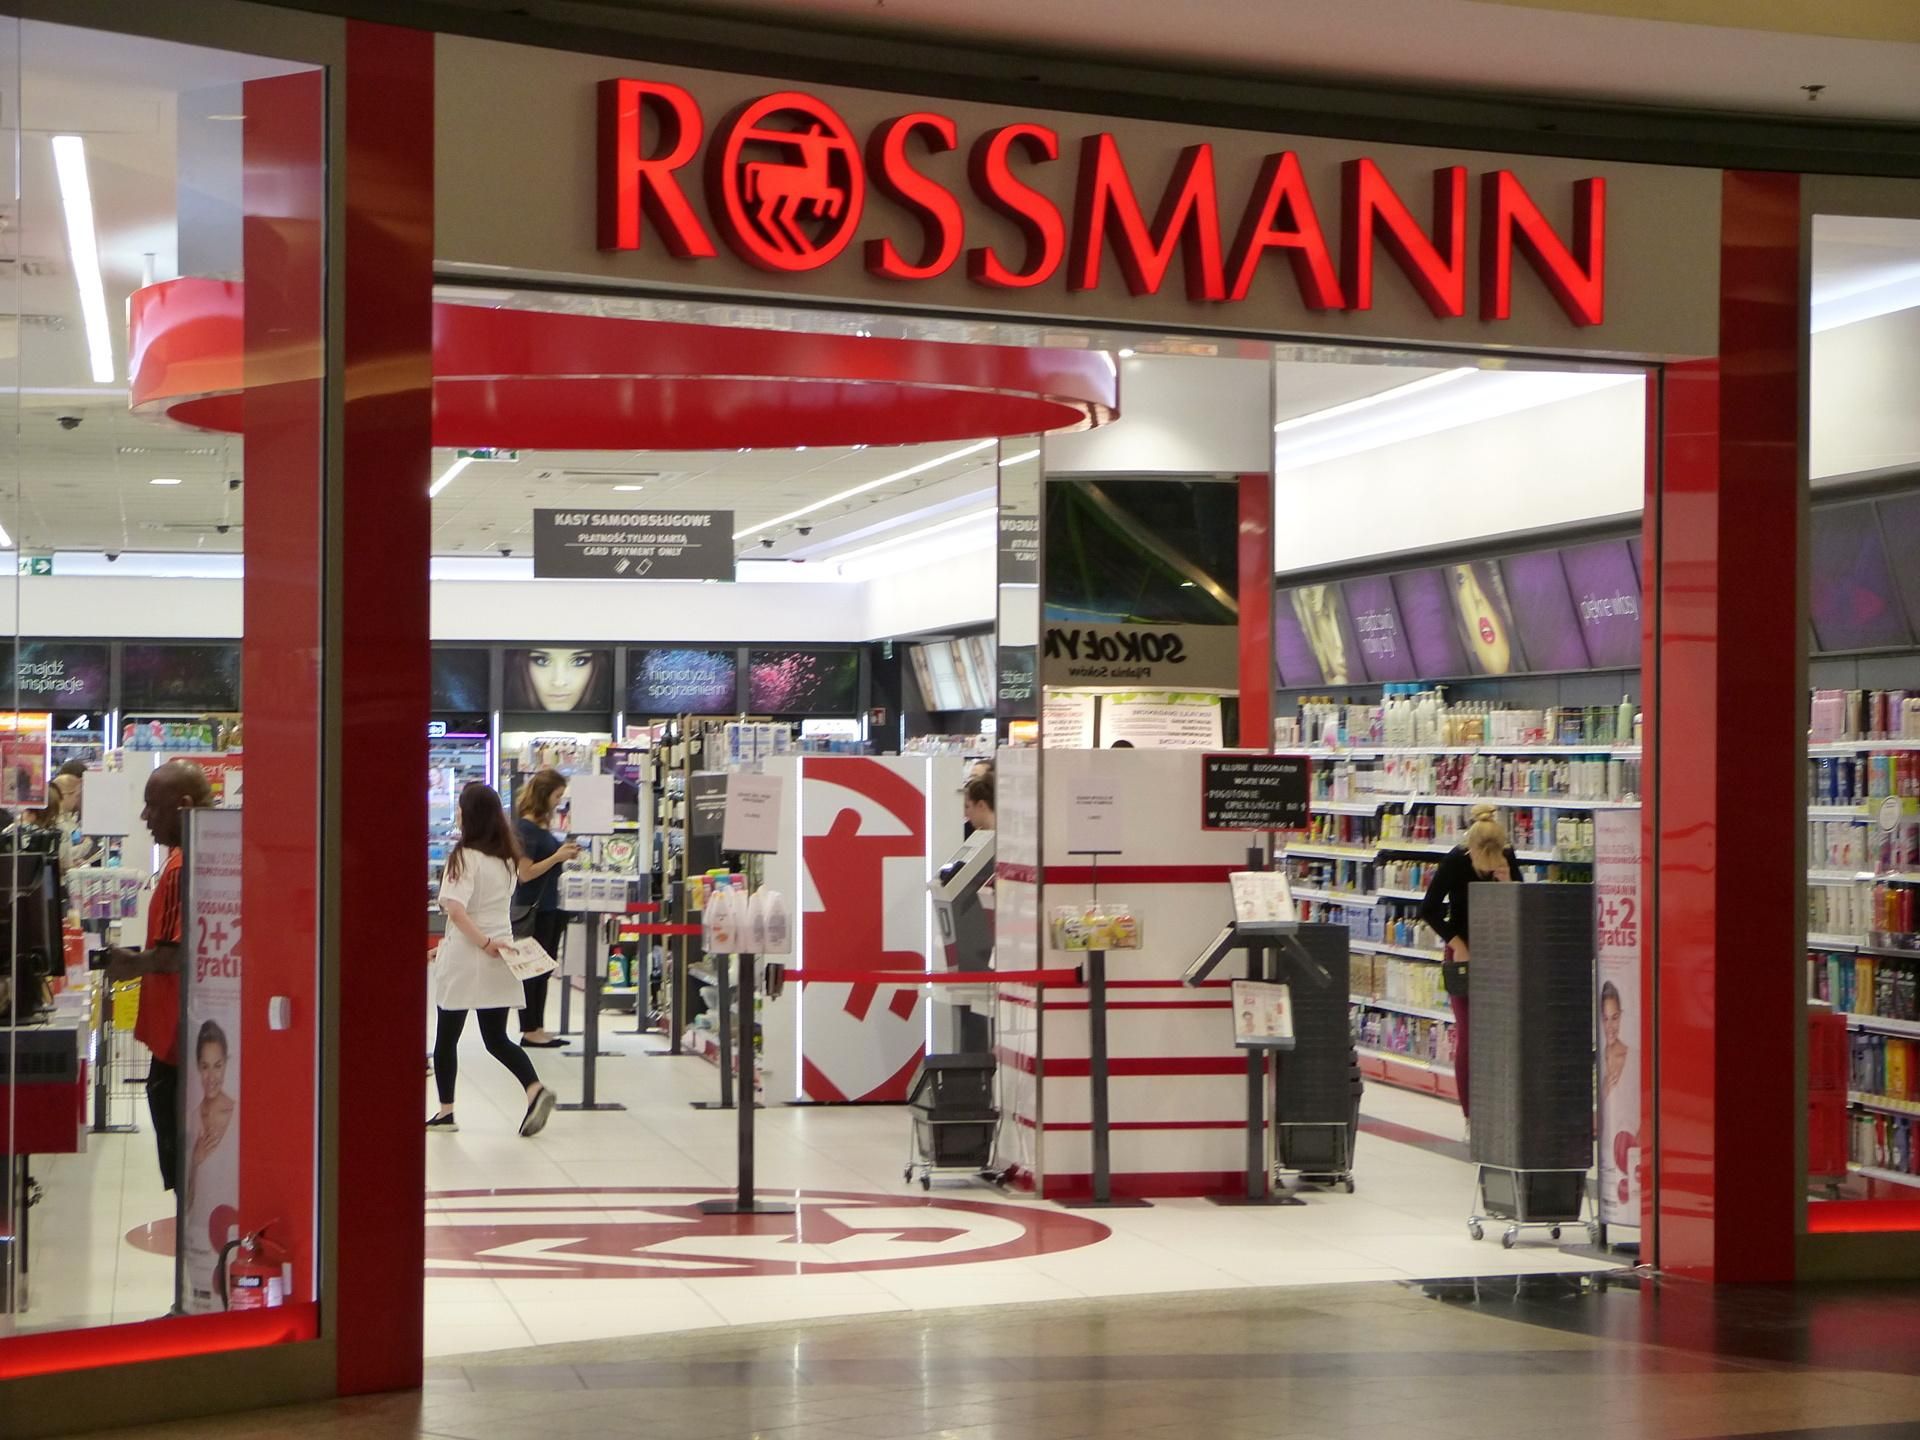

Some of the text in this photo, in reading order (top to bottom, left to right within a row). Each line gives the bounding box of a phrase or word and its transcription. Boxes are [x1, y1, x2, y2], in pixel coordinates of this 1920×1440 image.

[598, 77, 1607, 327] ROSSMANN
[554, 513, 711, 527] KASY SAMOOBSŁUGOWE
[578, 532, 626, 544] PŁATNOŚĆ
[627, 534, 656, 543] TYLKO
[583, 547, 683, 557] CARD PAYMENT ONLY
[17, 660, 64, 679] znajdź
[648, 683, 729, 700] spojrzeniem
[196, 953, 242, 983] grati
